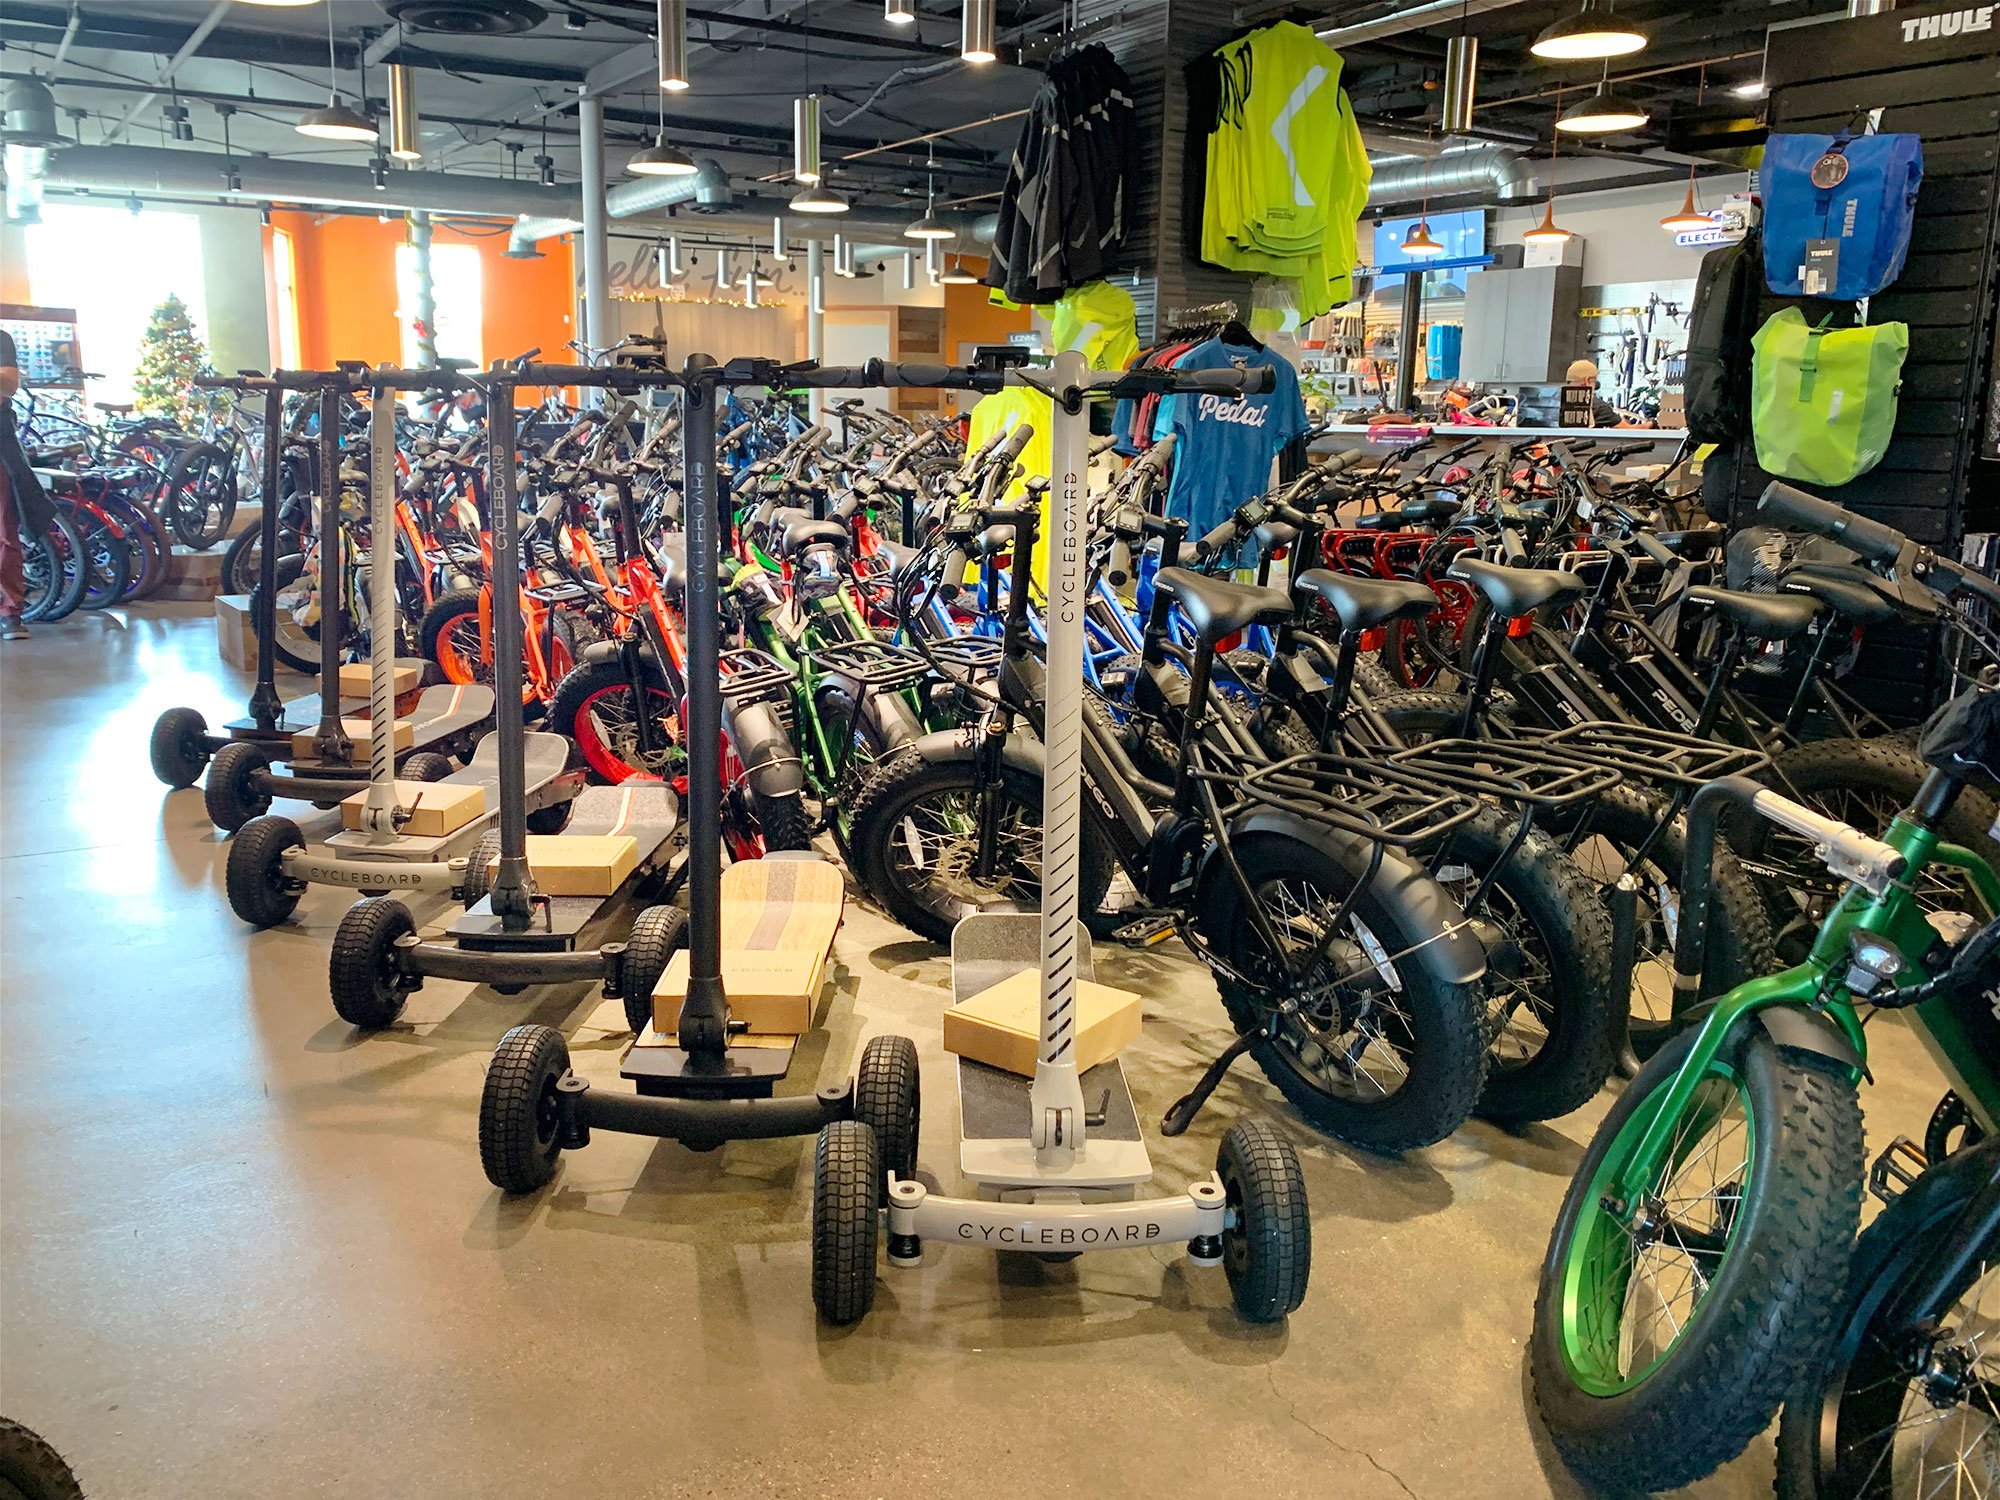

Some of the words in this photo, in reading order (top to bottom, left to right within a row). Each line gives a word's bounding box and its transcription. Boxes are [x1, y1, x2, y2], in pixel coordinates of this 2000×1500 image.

[1901, 6, 1993, 42] THULE
[1841, 198, 1858, 237] THULE
[1680, 232, 1726, 243] ELECTR
[1199, 393, 1268, 427] Pedal
[375, 447, 384, 534] CYCLEBOARD
[492, 444, 508, 551] CYCLEBOARD
[691, 461, 707, 593] CYCLEBOARD
[1061, 472, 1077, 623] CYCLEBOARD
[1652, 688, 1696, 733] PEDE
[310, 867, 422, 885] CYCLEBOARD
[1740, 862, 1778, 878] EMENT
[958, 1223, 1160, 1244] CYCLEBOARD
